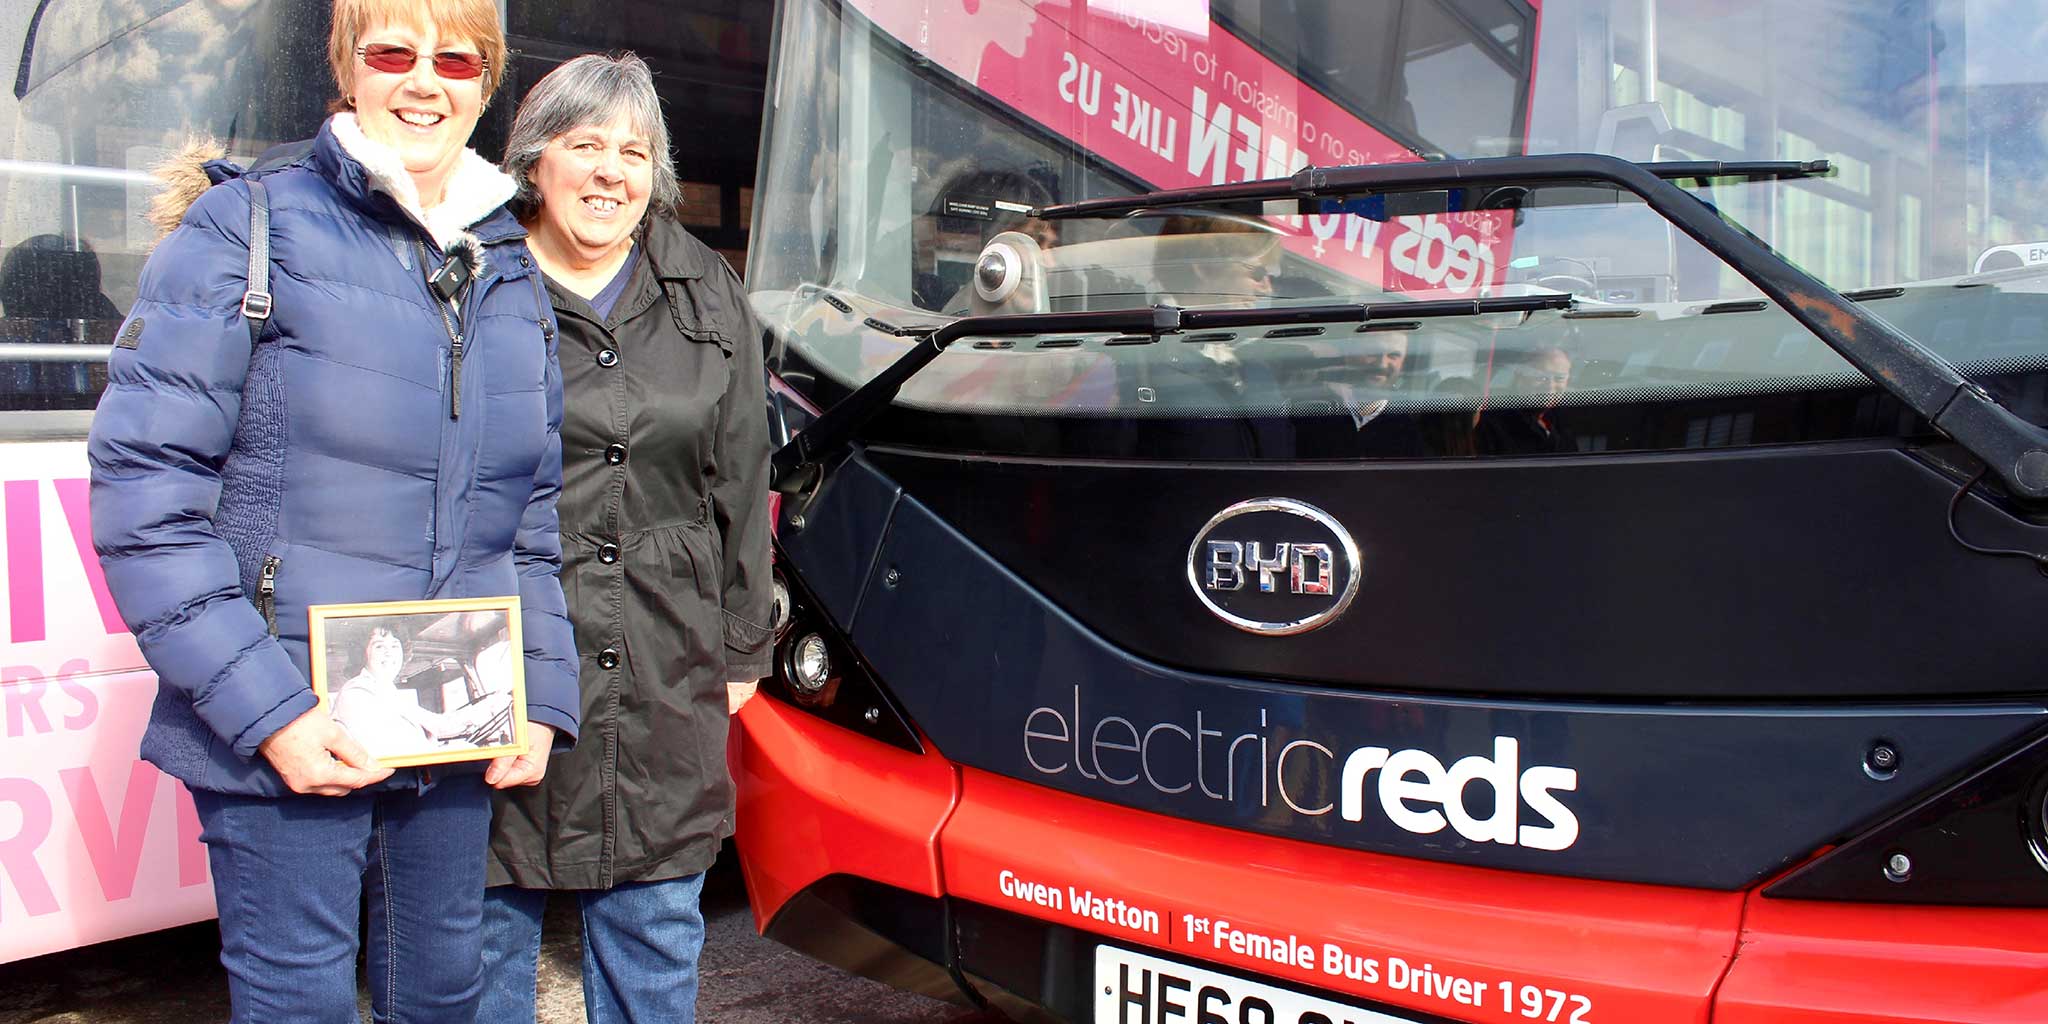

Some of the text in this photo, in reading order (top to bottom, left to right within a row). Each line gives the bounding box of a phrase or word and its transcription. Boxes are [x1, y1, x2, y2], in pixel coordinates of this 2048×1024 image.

[1206, 540, 1333, 595] BYD
[999, 869, 1592, 1024] Gwen Watton 1st Female Bus Driver 1972
